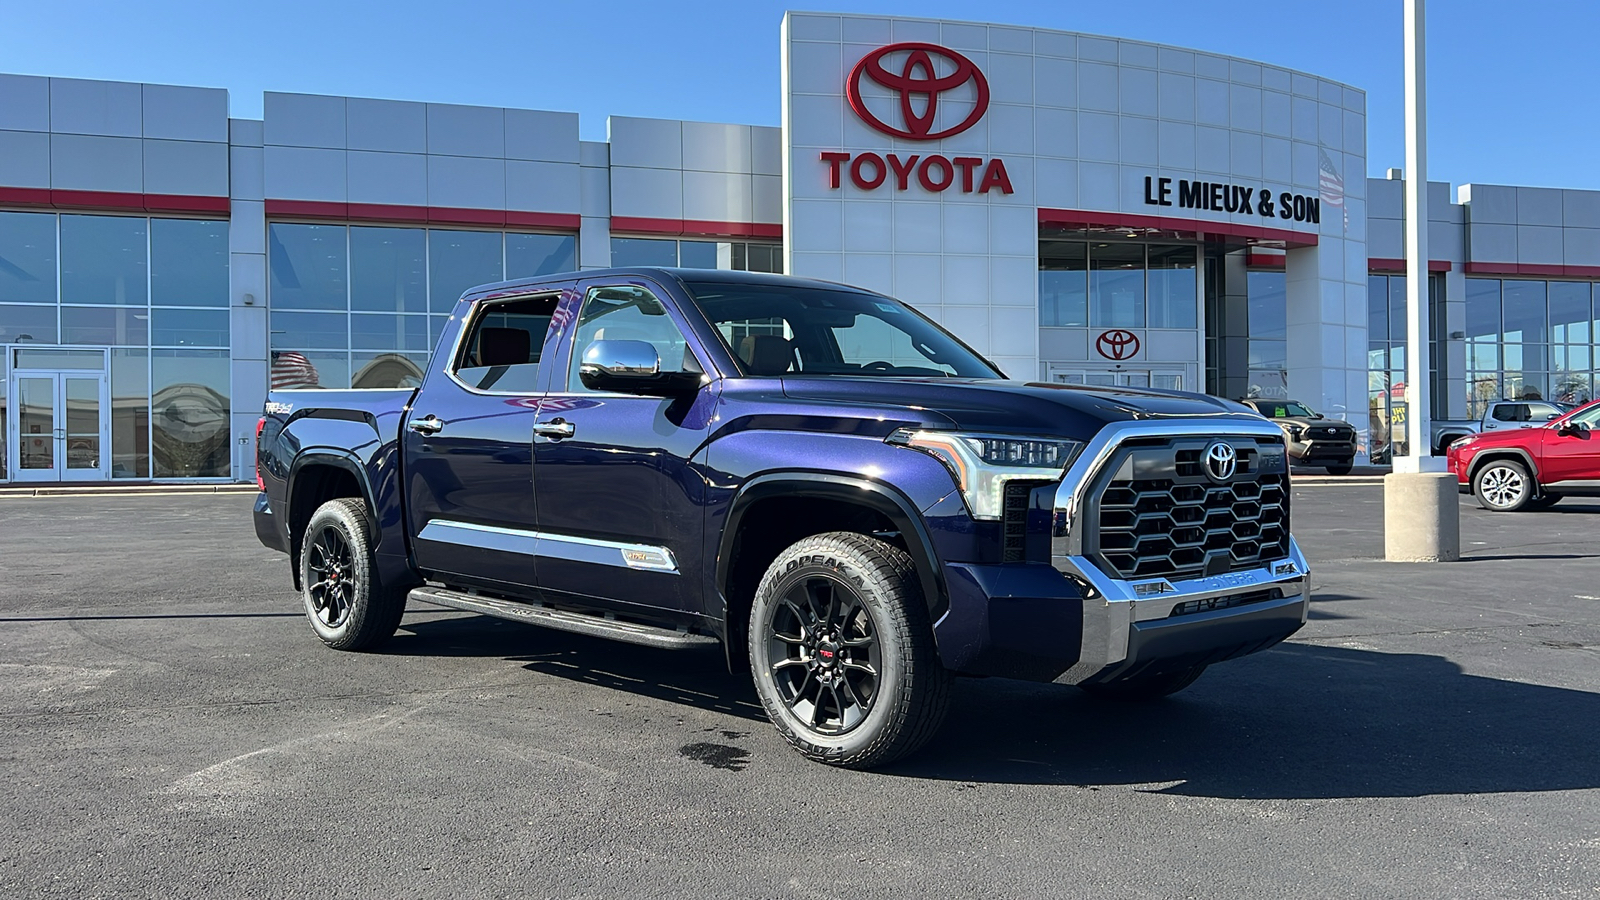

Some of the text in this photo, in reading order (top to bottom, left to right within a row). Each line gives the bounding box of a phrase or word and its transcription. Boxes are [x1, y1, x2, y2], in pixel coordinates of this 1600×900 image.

[820, 152, 1014, 195] TOYOTA
[1145, 176, 1320, 224] LE MIEUX & SON
[761, 555, 852, 606] WILDPEAK
